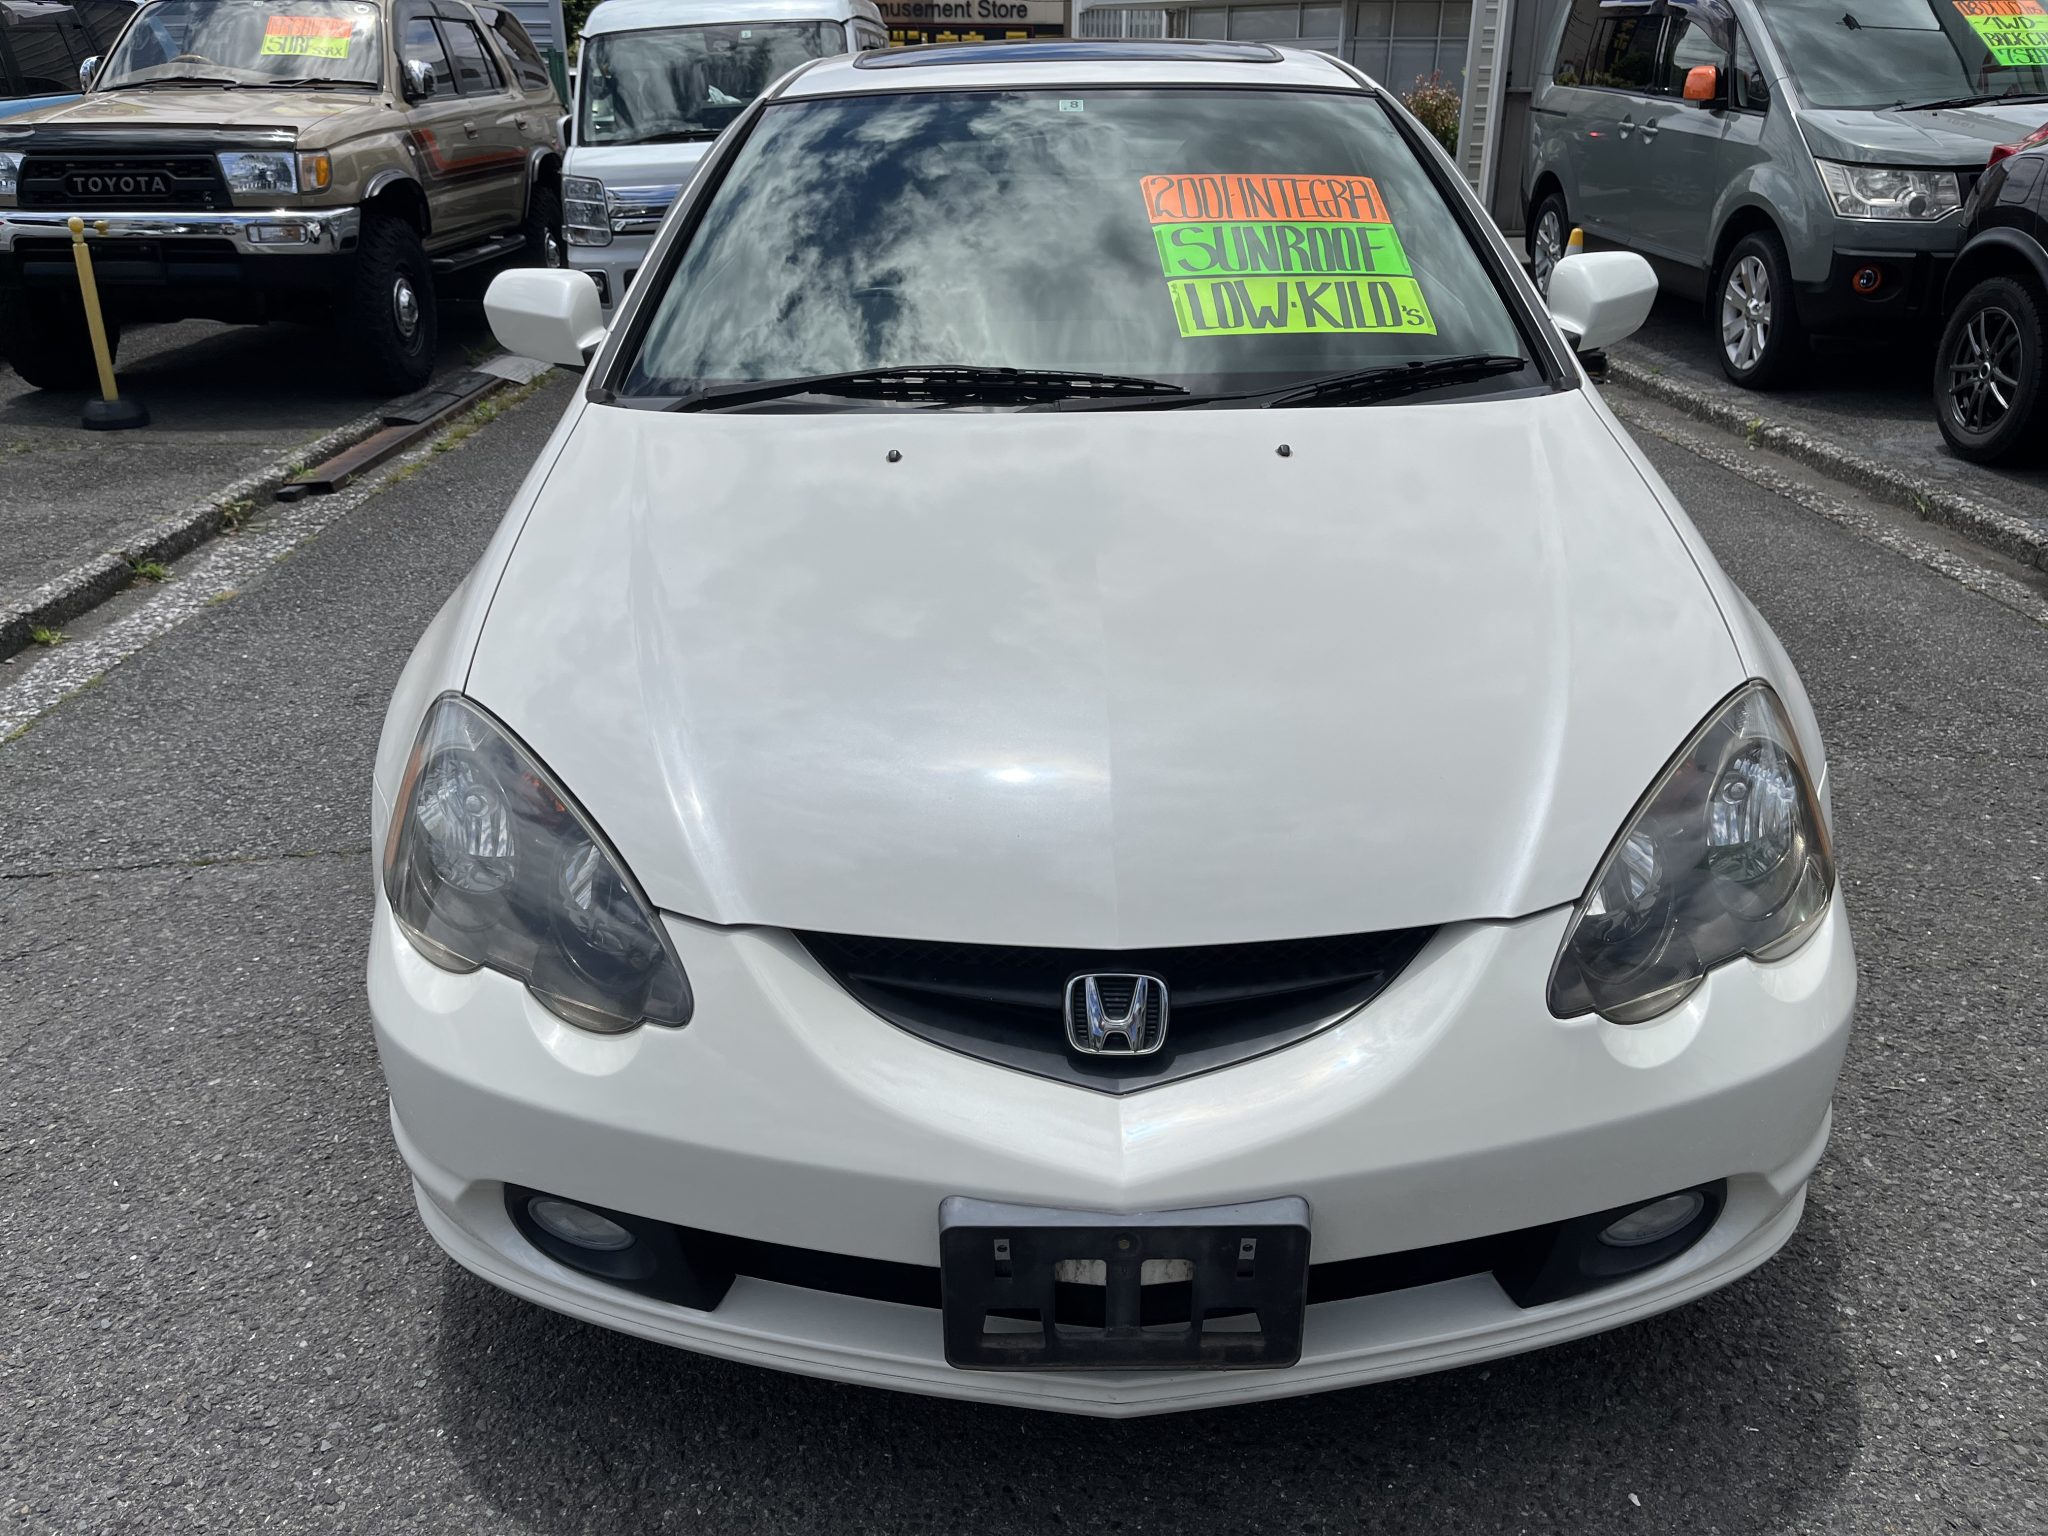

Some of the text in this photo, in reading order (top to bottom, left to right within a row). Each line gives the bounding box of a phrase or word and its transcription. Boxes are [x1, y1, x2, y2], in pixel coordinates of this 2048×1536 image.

[978, 0, 1028, 19] Store
[73, 176, 166, 193] TOYOTA
[1170, 224, 1386, 273] SUNROOF
